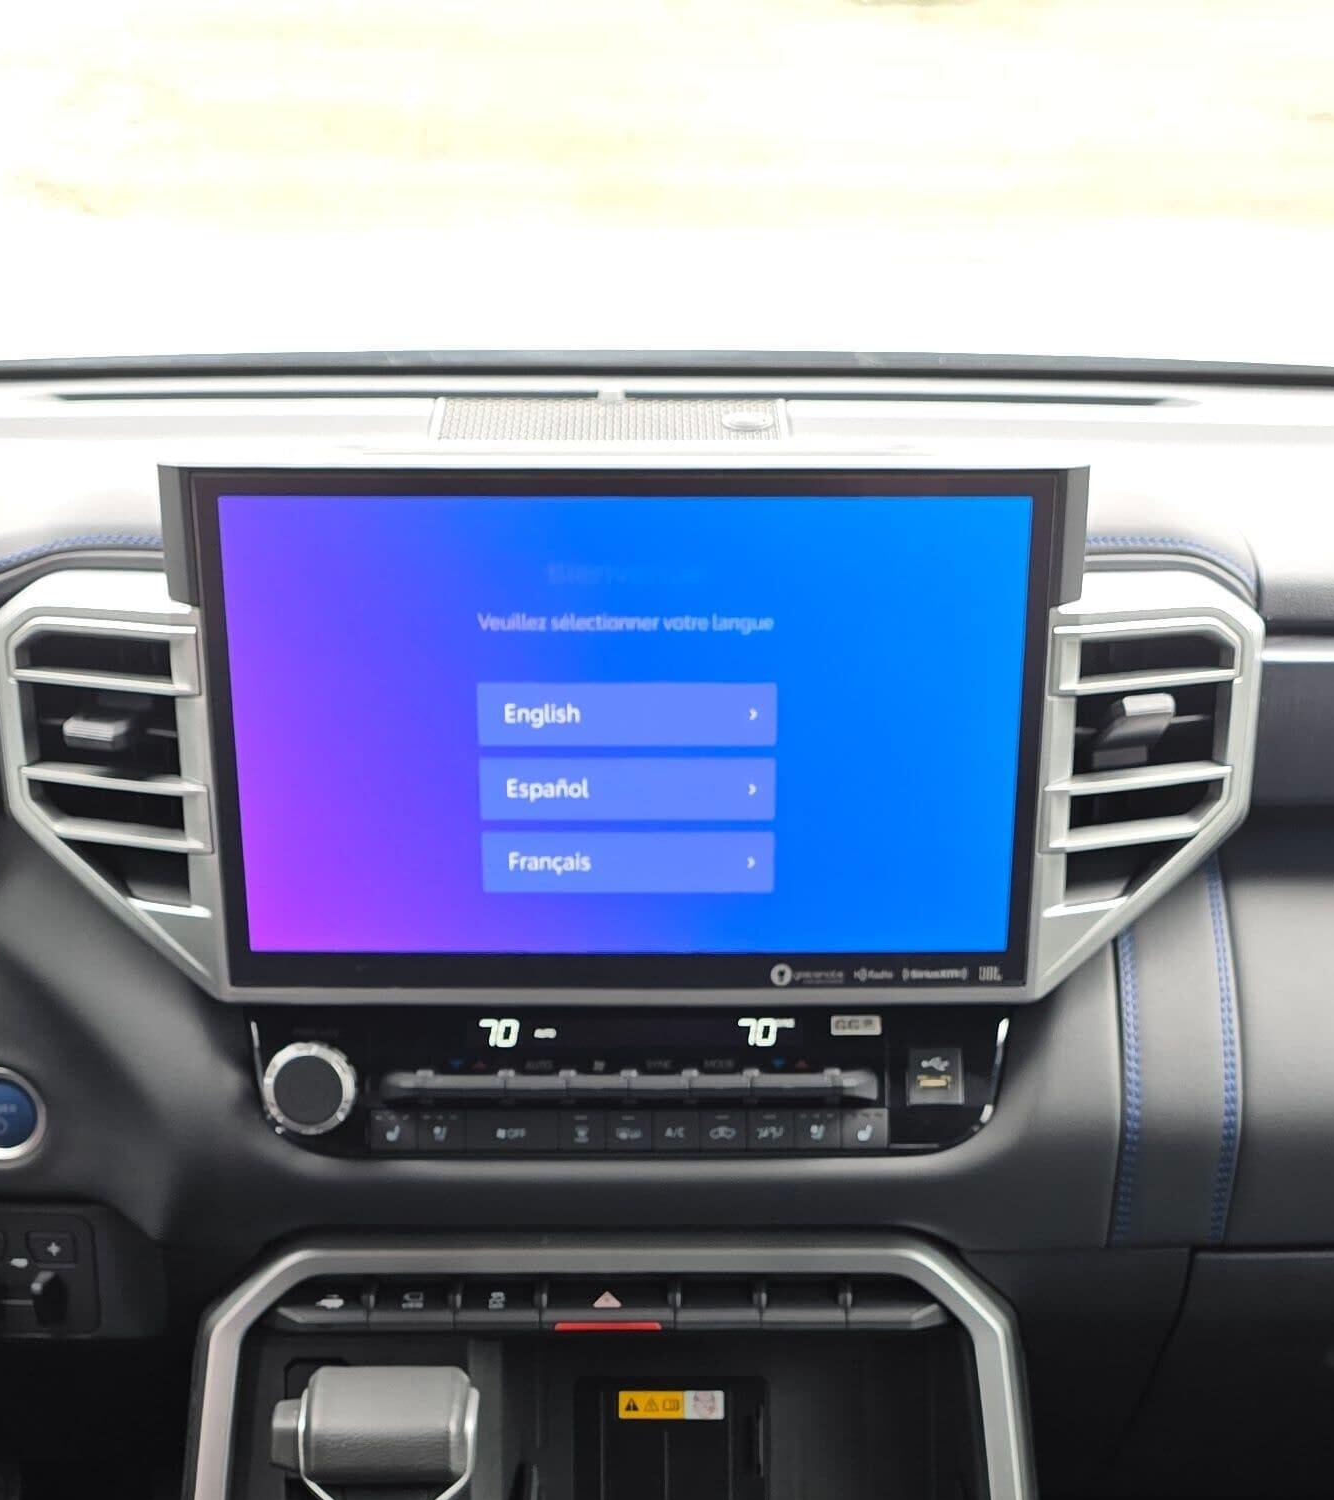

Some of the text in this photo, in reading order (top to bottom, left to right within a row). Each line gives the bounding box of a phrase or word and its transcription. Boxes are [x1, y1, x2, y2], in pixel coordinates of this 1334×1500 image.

[476, 612, 774, 636] Veuillez sélectionner votre langue
[504, 703, 581, 729] English
[505, 777, 590, 803] Español
[508, 851, 592, 876] Français
[478, 1018, 520, 1048] 70
[737, 1017, 778, 1047] 70
[663, 1126, 685, 1139] A/C
